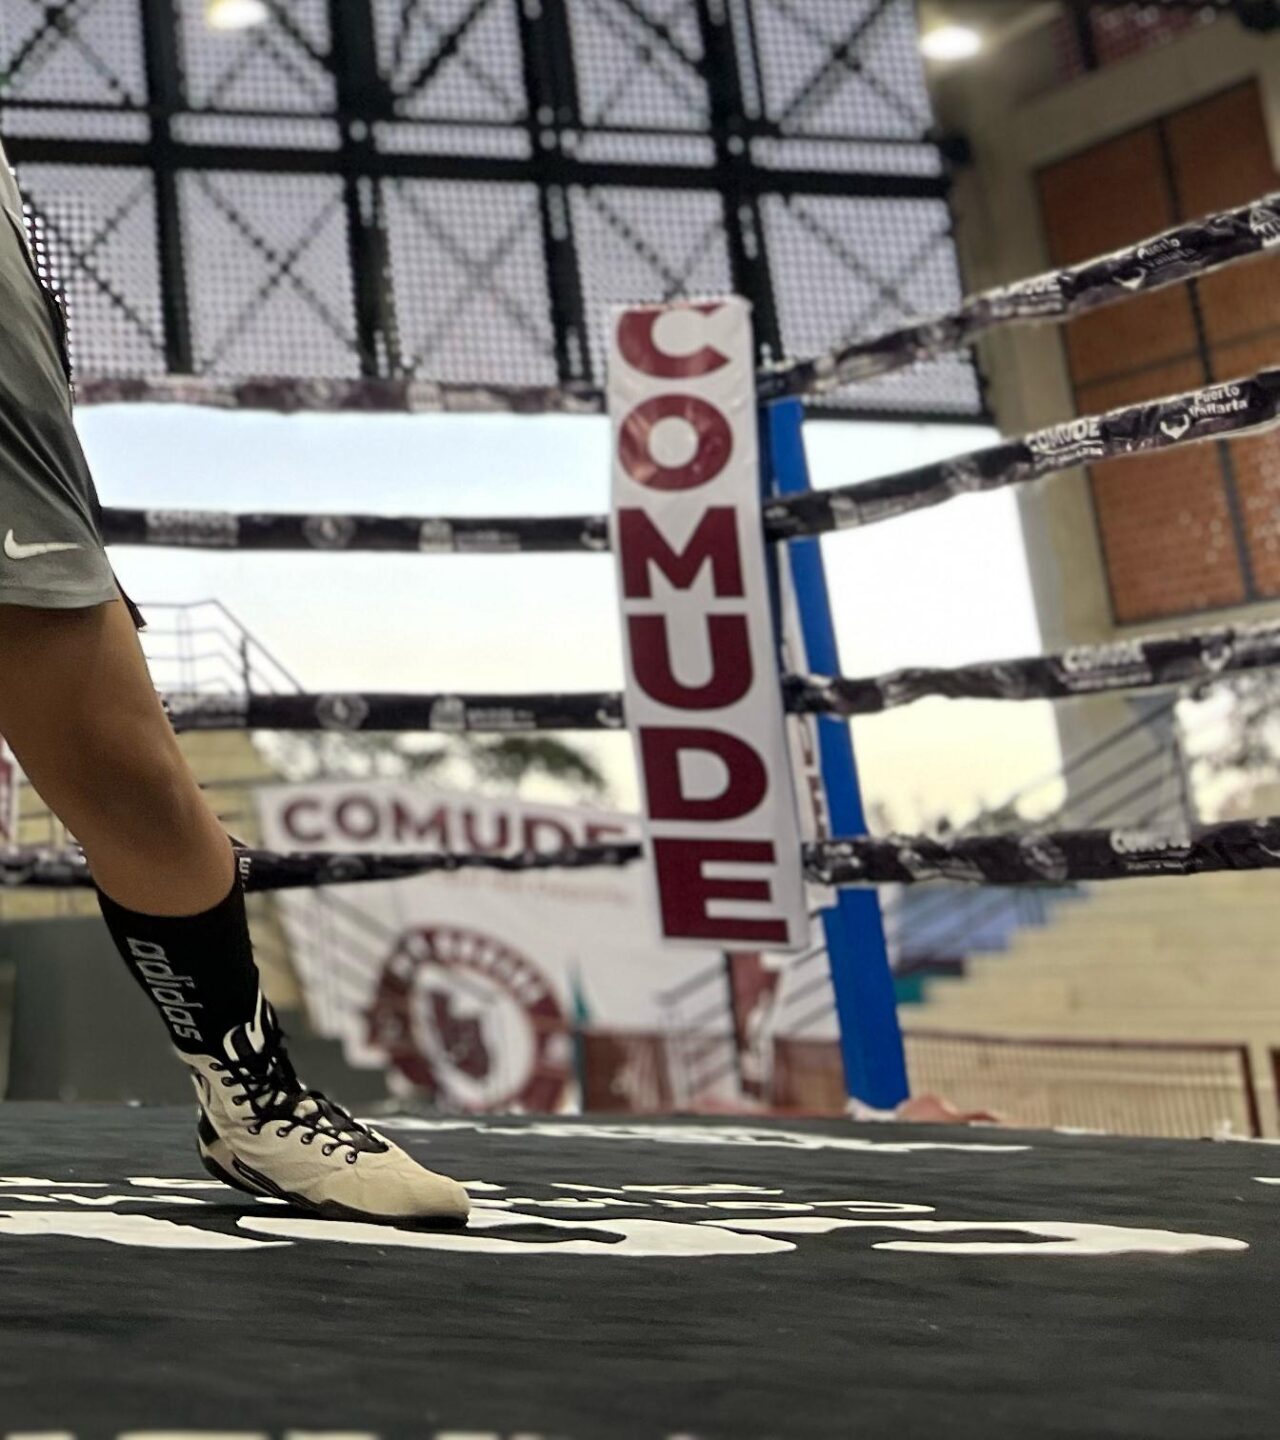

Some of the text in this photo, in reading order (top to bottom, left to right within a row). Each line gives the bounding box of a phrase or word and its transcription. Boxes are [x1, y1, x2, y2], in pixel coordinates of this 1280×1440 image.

[1188, 398, 1249, 418] Vallarta
[1193, 385, 1240, 406] Puerto
[1025, 421, 1101, 452] COMUDE
[617, 303, 790, 943] COMUDE
[126, 936, 203, 1042] adidas
